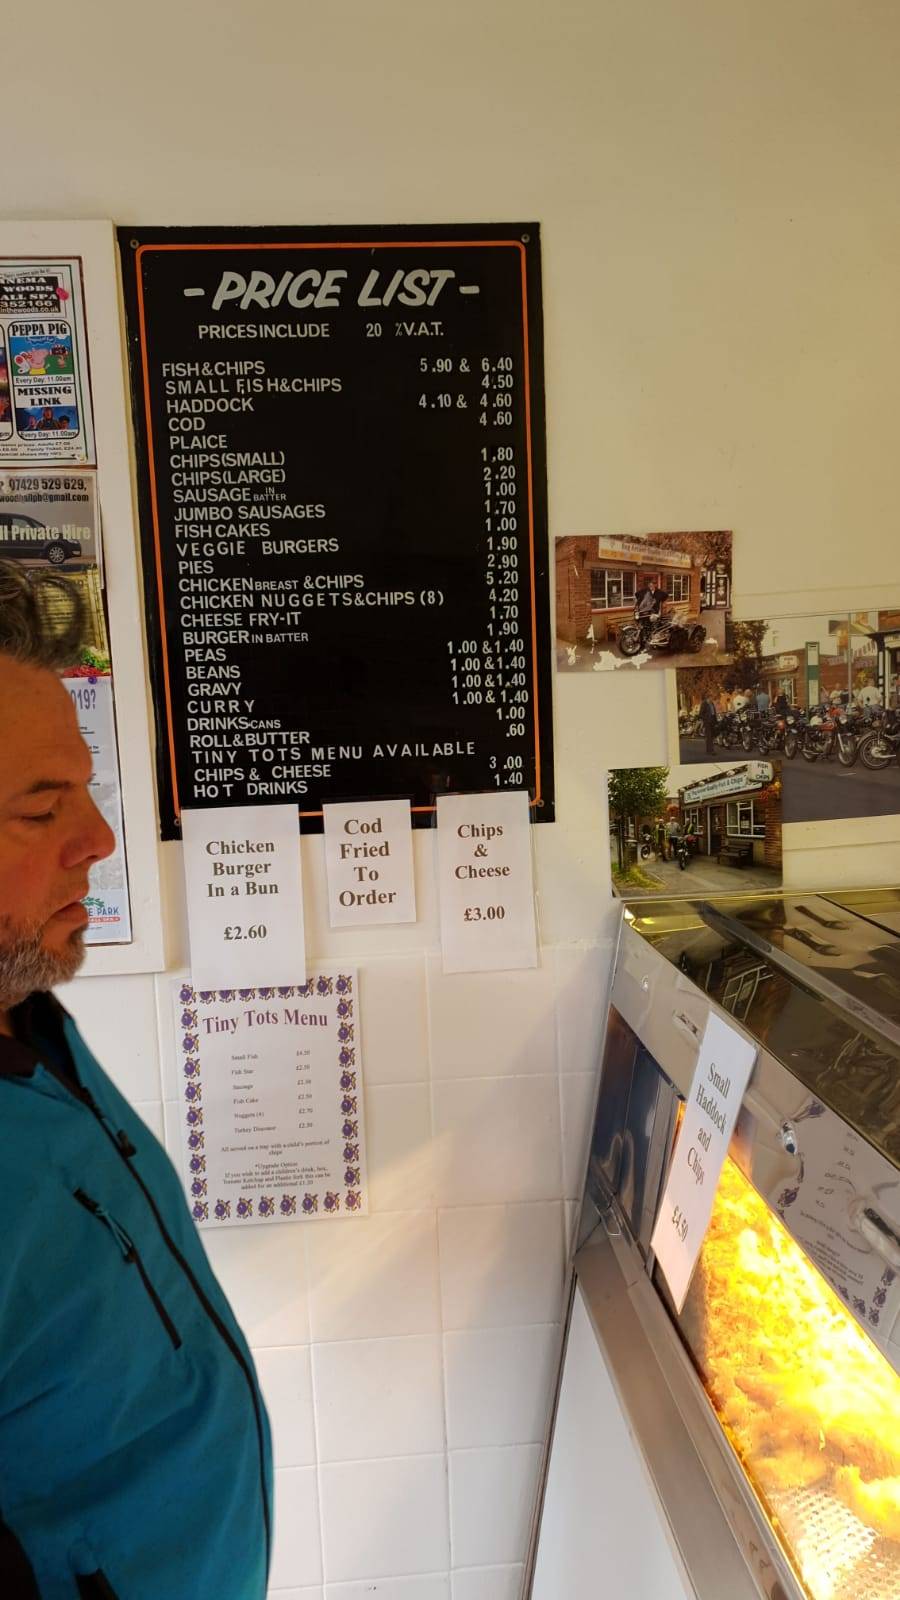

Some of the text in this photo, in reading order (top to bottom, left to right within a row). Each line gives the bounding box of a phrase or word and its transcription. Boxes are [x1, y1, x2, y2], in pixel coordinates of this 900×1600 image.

[211, 269, 456, 311] PRICE LIST
[12, 323, 67, 336] PEPPA PIG
[198, 323, 257, 339] PRICES
[259, 323, 330, 338] INCLUDE
[366, 323, 382, 337] 20
[420, 357, 513, 372] 5.90 & 6.40
[165, 379, 229, 395] SMALL
[481, 374, 514, 389] 4.50
[17, 386, 72, 396] MISSING
[30, 398, 62, 406] LINK
[166, 397, 254, 413] HADDOCK
[418, 393, 513, 409] 4.10 & 4.60
[168, 417, 206, 432] COD
[479, 411, 513, 426] 4.60
[20, 430, 37, 438] Every
[170, 434, 228, 449] PLAICE
[483, 465, 516, 481] 2.20
[9, 478, 39, 491] 07429
[41, 478, 61, 490] 529
[485, 481, 516, 496] 1.00
[173, 487, 251, 503] SAUSAGE
[253, 493, 287, 501] BATTER
[174, 504, 326, 521] JUMBO SAUSAGES
[484, 499, 516, 515] 1.70
[175, 523, 271, 538] FISH CAKES
[485, 517, 517, 531] 1.00
[12, 525, 60, 540] Private
[62, 524, 91, 540] Hire
[176, 538, 339, 557] VEGGIE BURGERS
[487, 536, 518, 551] 1.90
[178, 560, 214, 575] PIES
[487, 554, 518, 569] 2.90
[178, 577, 253, 592] CHICKEN
[254, 580, 299, 591] BREAST
[486, 571, 518, 585] 5.20
[180, 594, 254, 610] CHICKEN
[420, 590, 444, 606] (8)
[489, 588, 519, 602] 4.20
[180, 611, 302, 628] CHEESE FRY-IT
[489, 605, 519, 620] 1.70
[487, 621, 519, 636] 1.90
[183, 630, 309, 645] BURGER IN BATTER
[447, 640, 477, 655] 1.00
[184, 648, 227, 663] PEAS
[186, 665, 241, 680] BEANS
[450, 658, 480, 672] 1.00
[452, 674, 481, 688] 1.00
[187, 682, 242, 697] GRAVY
[452, 691, 482, 705] 1.00
[187, 700, 255, 714] CURRY
[496, 706, 525, 720] 1.00
[506, 723, 525, 737] .60
[192, 741, 476, 764] TINY TOTS MENU AVAILABLE
[489, 756, 523, 770] 3.00
[194, 764, 332, 782] CHIPS & CHEESE
[494, 771, 523, 786] 1.40
[193, 781, 308, 798] HOT DRINKS
[344, 818, 383, 835] Cod
[457, 824, 504, 840] Chips
[206, 840, 275, 856] Chicken
[339, 841, 390, 859] Fried
[474, 843, 488, 858] &
[212, 861, 272, 878] Burger
[353, 866, 379, 882] To
[455, 865, 511, 880] Cheese
[208, 881, 279, 897] In a Bun
[339, 889, 397, 907] Order
[97, 907, 119, 916] PARK
[464, 906, 505, 922] £3.00
[224, 924, 267, 941] £2.60
[202, 1008, 328, 1035] Tiny Tots Menu
[708, 1062, 730, 1099] Small
[695, 1084, 727, 1136] Haddock
[697, 1126, 711, 1152] and
[687, 1147, 705, 1186] Chips
[671, 1205, 689, 1242] £4.50
